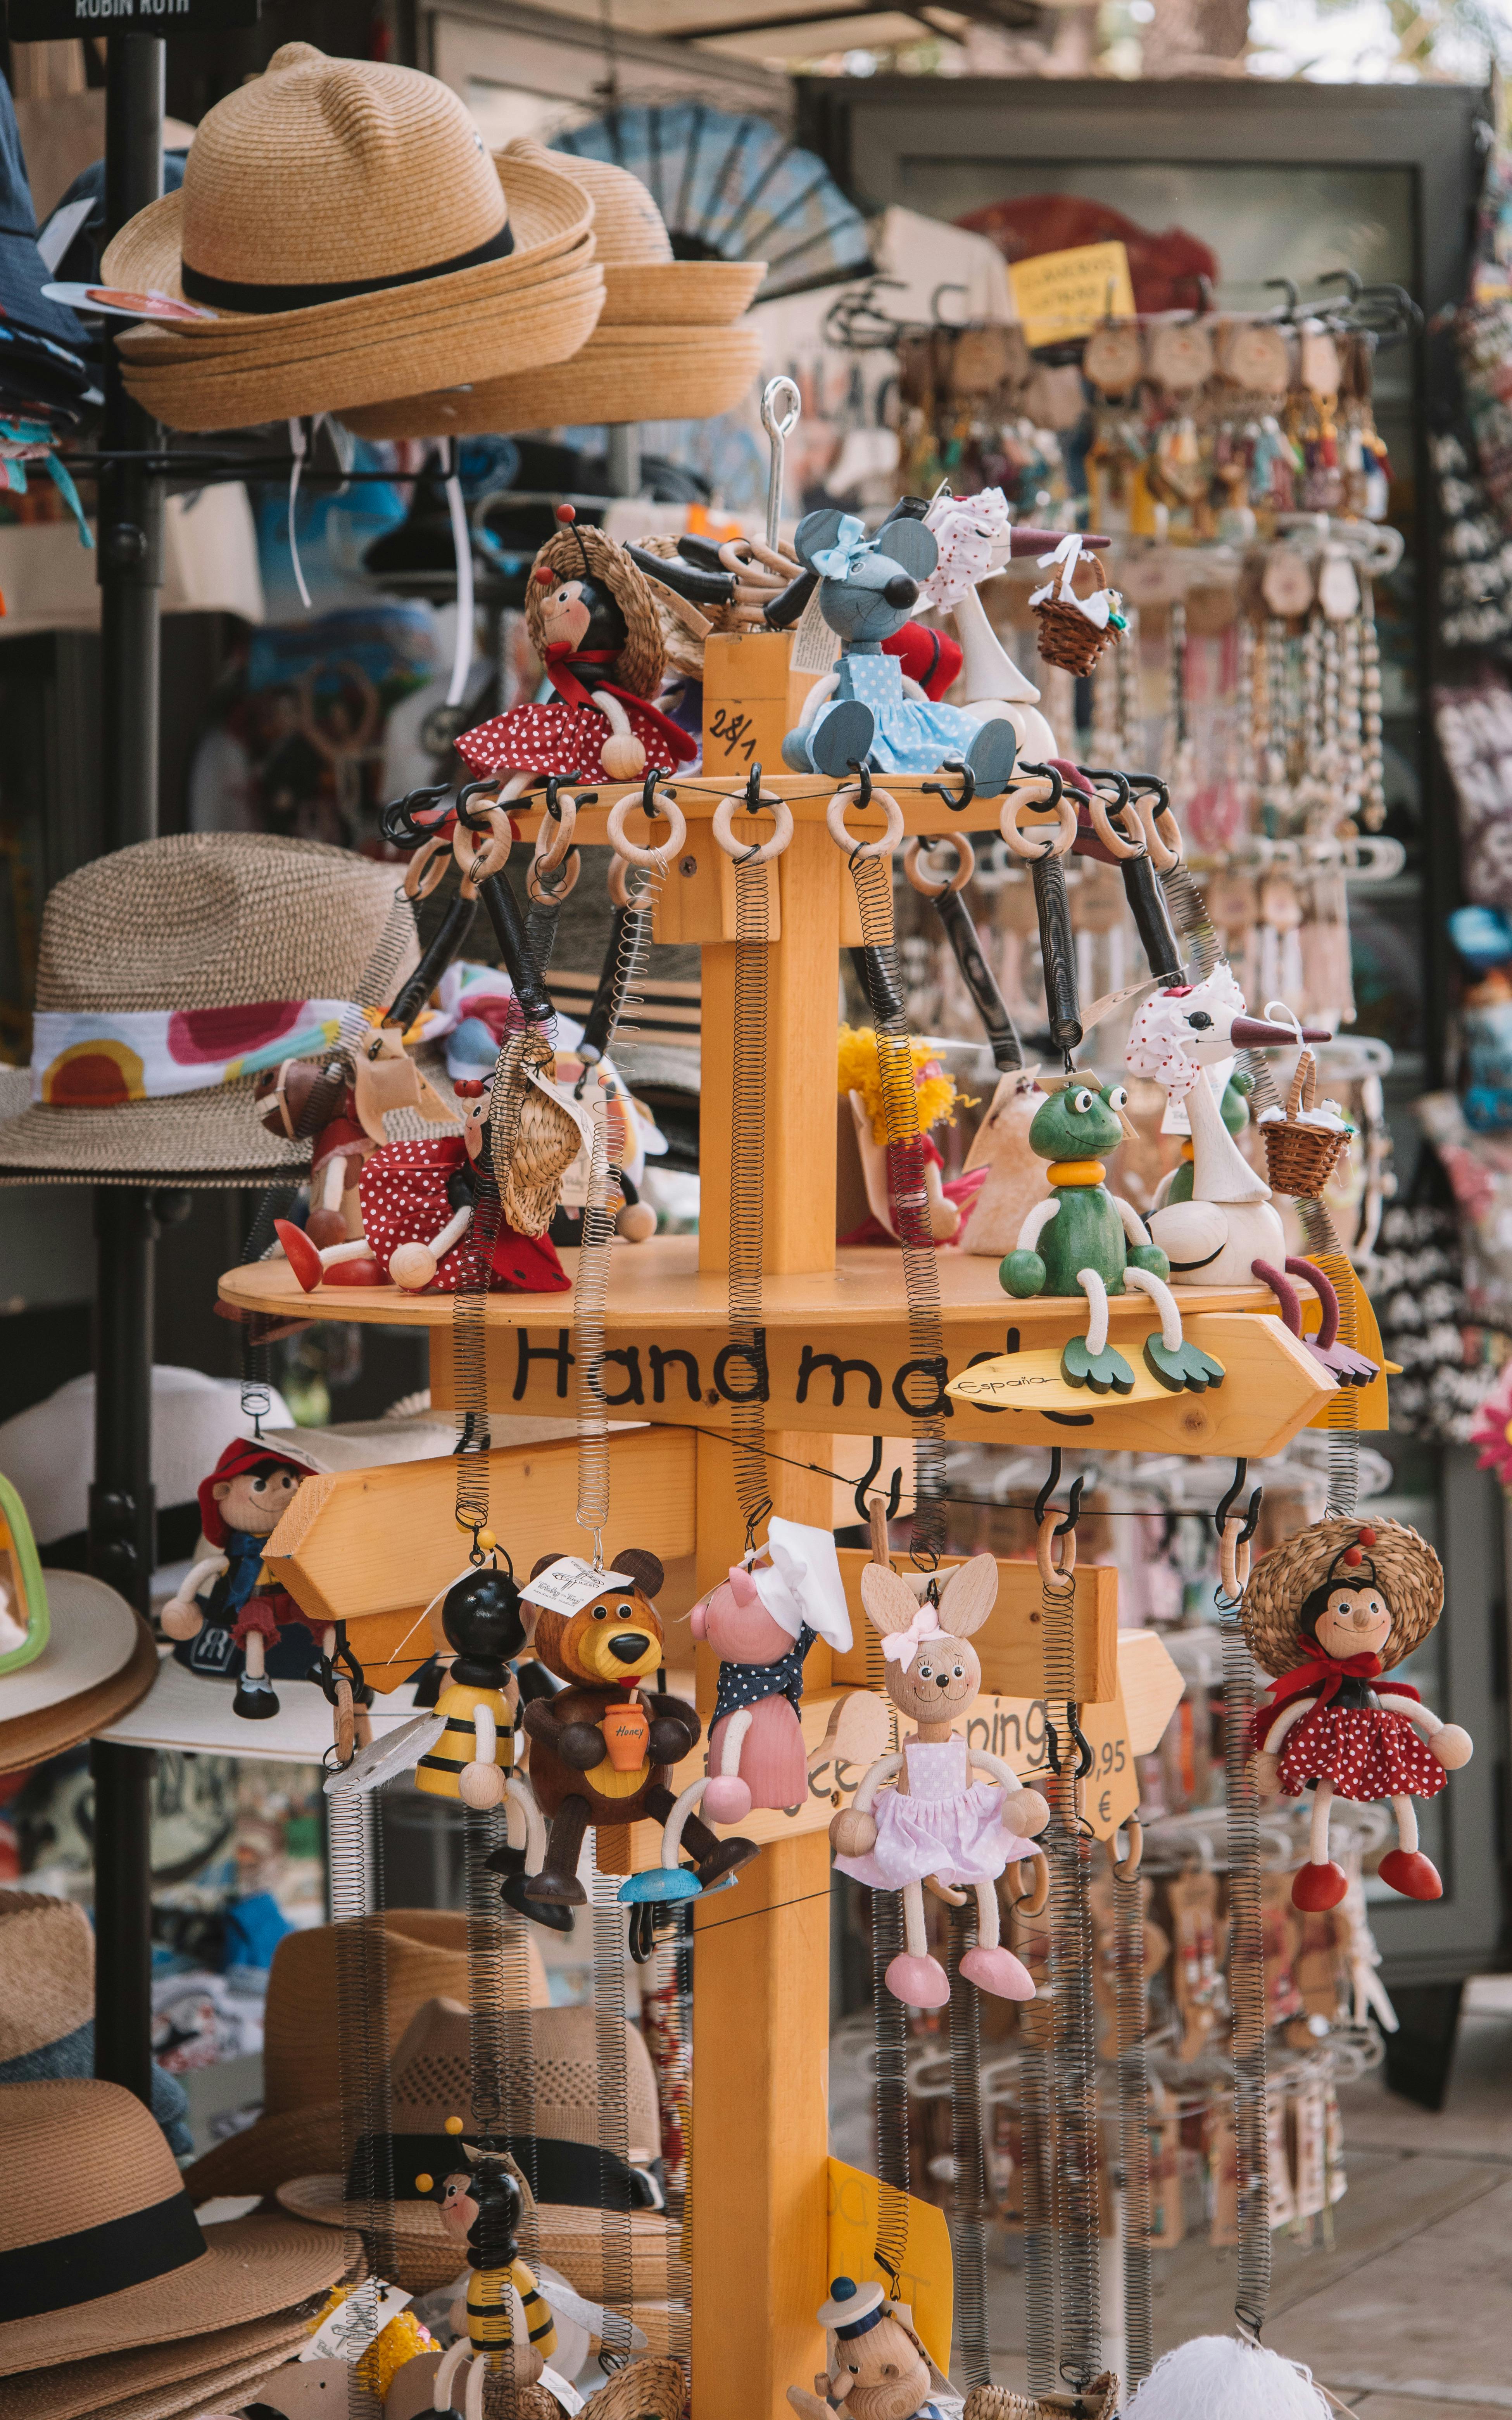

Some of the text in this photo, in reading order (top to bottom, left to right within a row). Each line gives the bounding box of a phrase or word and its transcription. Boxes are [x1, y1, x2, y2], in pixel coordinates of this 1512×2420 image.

[513, 1327, 770, 1405] Hand
[953, 1376, 1062, 1393] España
[616, 1725, 644, 1739] Honey
